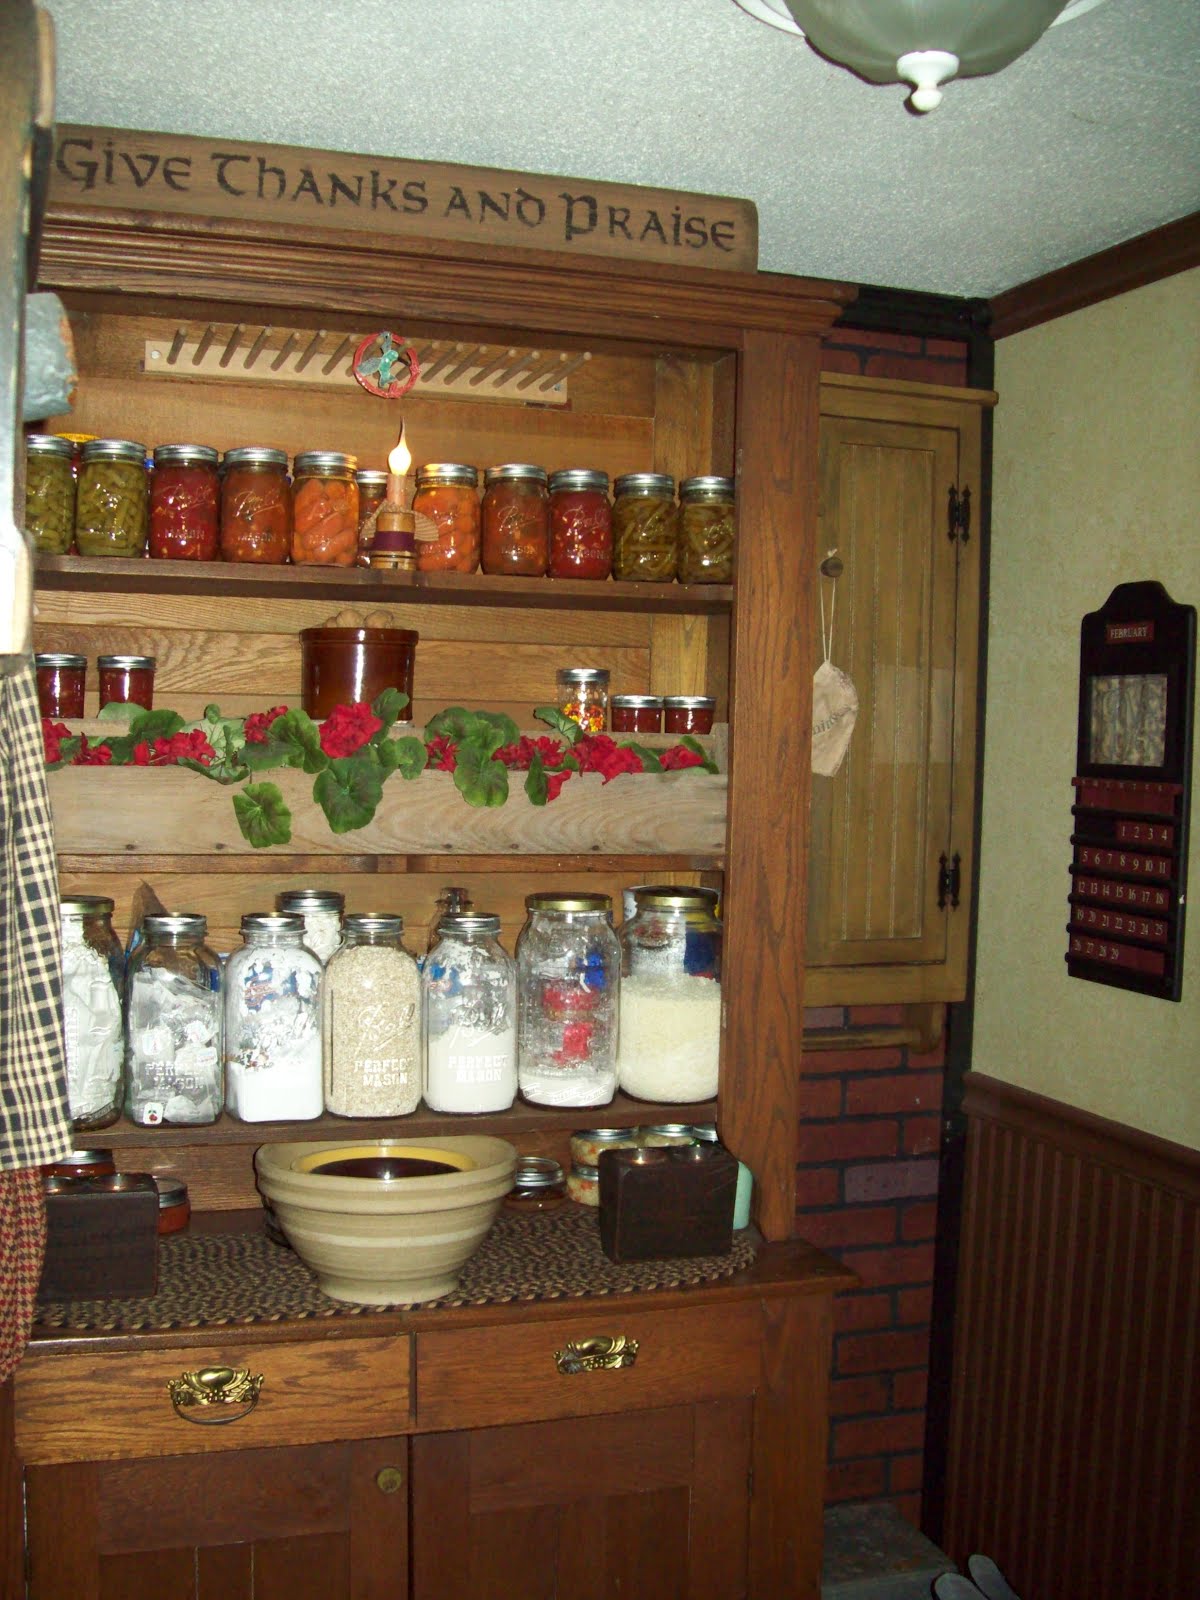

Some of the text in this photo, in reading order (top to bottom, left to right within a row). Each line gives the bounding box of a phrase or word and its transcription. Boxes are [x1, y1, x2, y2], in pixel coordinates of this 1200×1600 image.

[1121, 825, 1168, 841] 1 2 3 4
[1082, 850, 1166, 874] 5 6 7 8 9 10 11
[1078, 881, 1164, 905] 12 13 14 15 16 17 18
[362, 1072, 408, 1088] MASON
